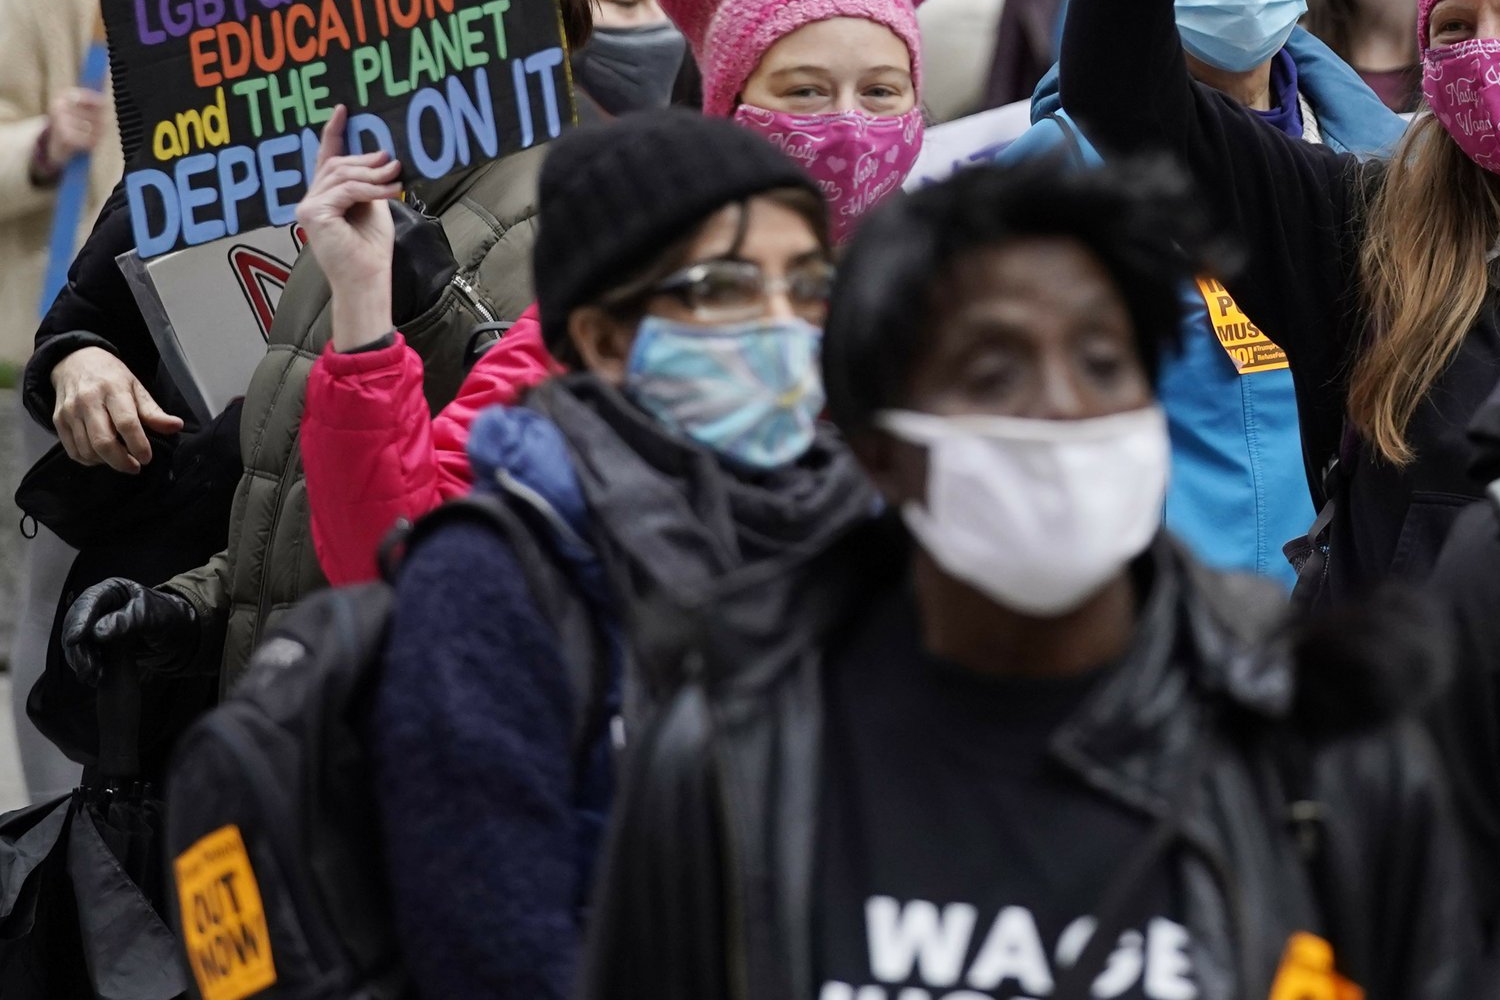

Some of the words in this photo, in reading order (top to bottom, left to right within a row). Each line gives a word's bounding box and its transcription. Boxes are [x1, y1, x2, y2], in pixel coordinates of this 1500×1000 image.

[153, 86, 231, 161] and
[232, 61, 335, 138] THE
[407, 66, 498, 180] ON
[512, 46, 564, 148] IT
[768, 131, 825, 168] Nasty
[1217, 321, 1260, 342] MUS
[193, 871, 241, 934] OUT
